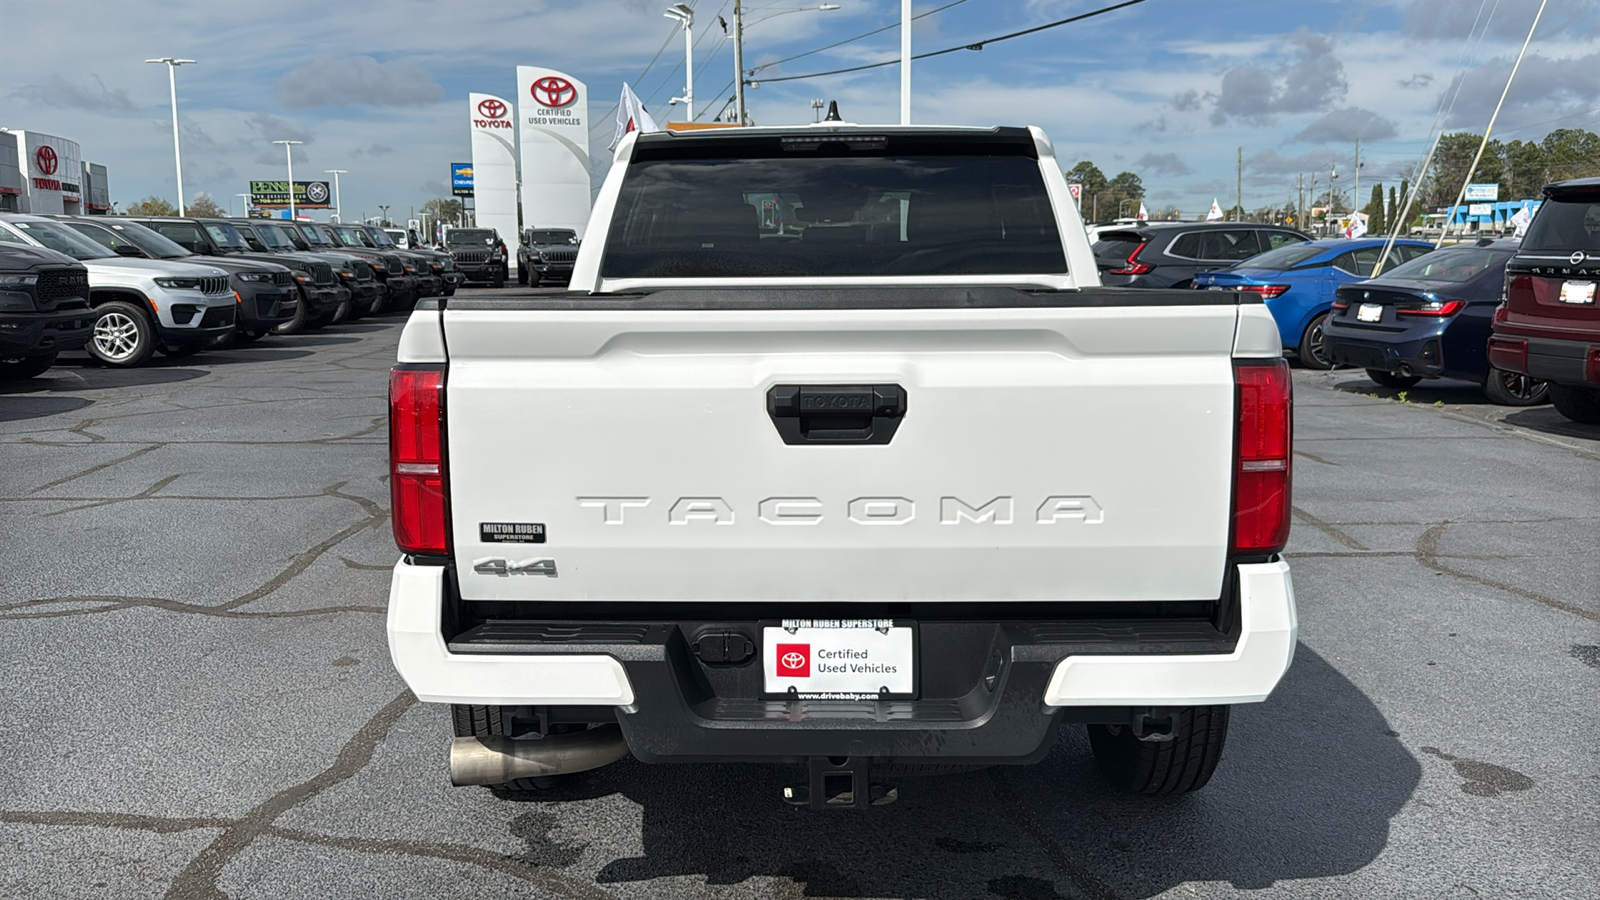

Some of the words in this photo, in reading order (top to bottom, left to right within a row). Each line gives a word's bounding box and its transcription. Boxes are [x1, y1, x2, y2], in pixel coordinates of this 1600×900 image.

[537, 108, 571, 117] CERTIFIED
[473, 119, 513, 129] TOYOTA
[528, 117, 548, 125] USED
[548, 118, 581, 126] VEHICLES
[33, 177, 62, 192] TOYOTA
[252, 181, 284, 193] PENN
[803, 395, 871, 408] TOYOTA
[575, 495, 1105, 525] TACOMA
[483, 524, 514, 534] MILTON
[515, 524, 543, 534] RUBEN
[782, 619, 811, 628] MILTON
[812, 619, 841, 628] RUBEN
[841, 619, 894, 628] SUPERSTORE
[817, 649, 868, 659] Certified
[817, 663, 847, 673] Used
[850, 663, 897, 674] Vehicles
[798, 692, 879, 701] www.drivebaby.com
